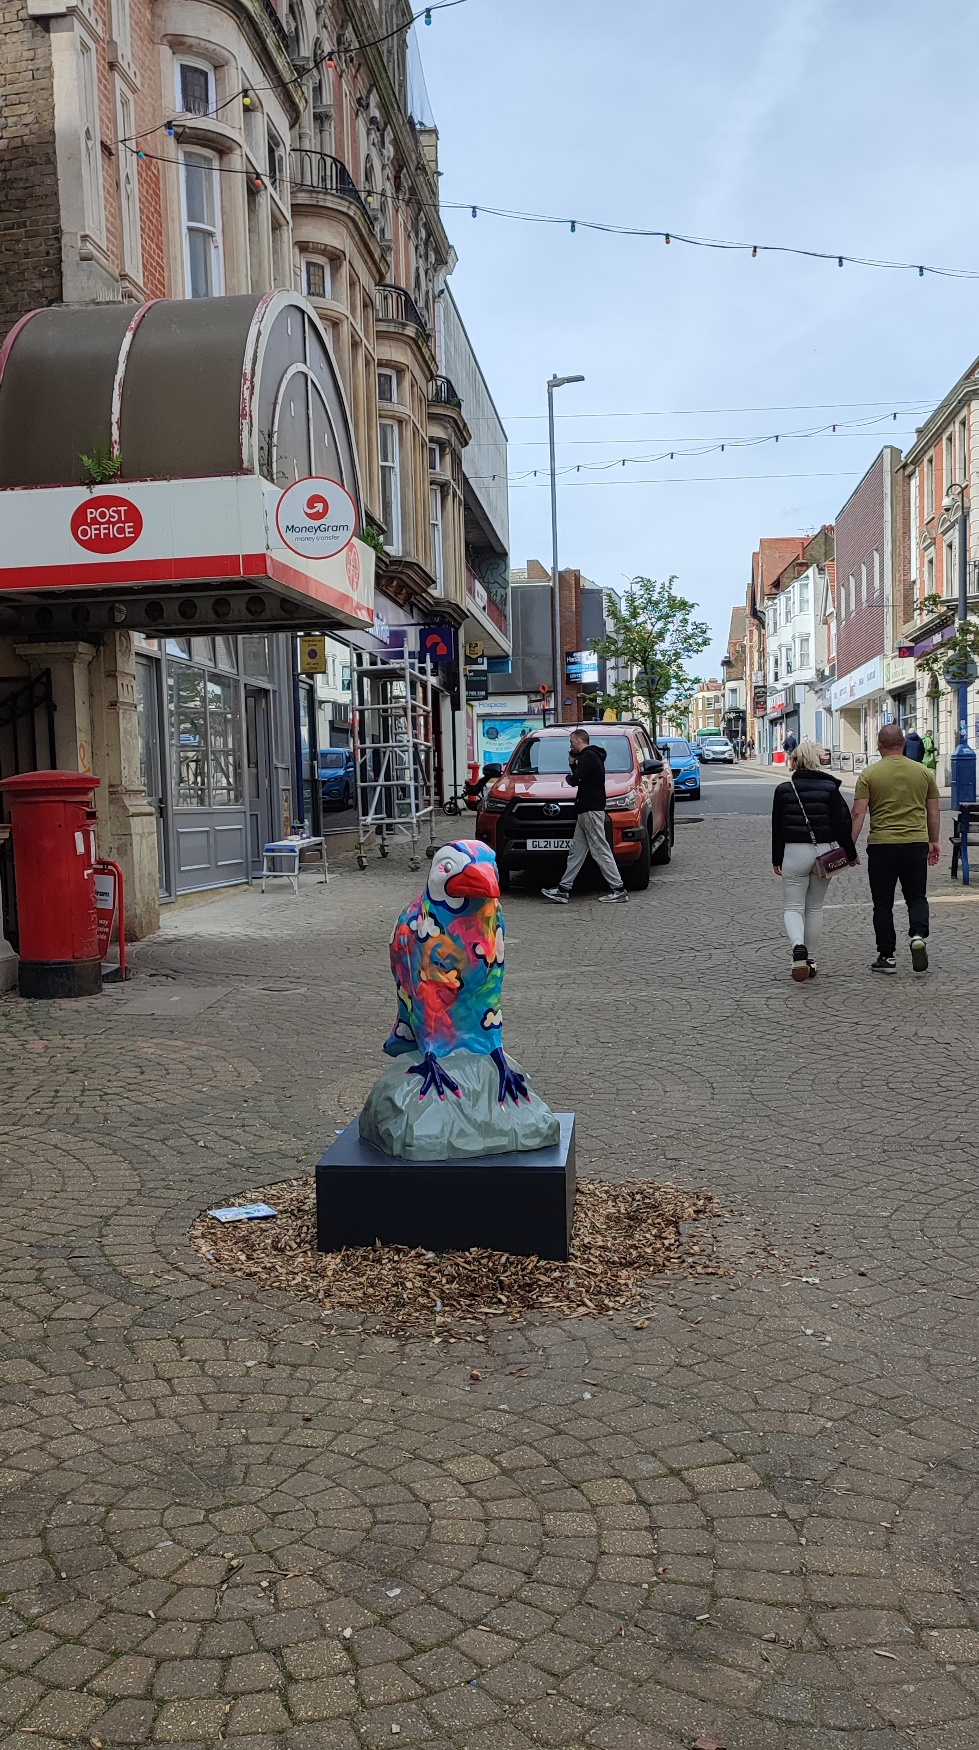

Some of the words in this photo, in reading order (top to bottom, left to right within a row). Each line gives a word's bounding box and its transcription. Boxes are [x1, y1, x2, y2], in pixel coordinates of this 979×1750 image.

[86, 506, 128, 523] POST
[77, 522, 135, 540] OFFICE
[285, 523, 349, 535] MoneyGram
[531, 840, 552, 849] GL21
[553, 840, 570, 849] UZX
[828, 857, 847, 869] GUESS
